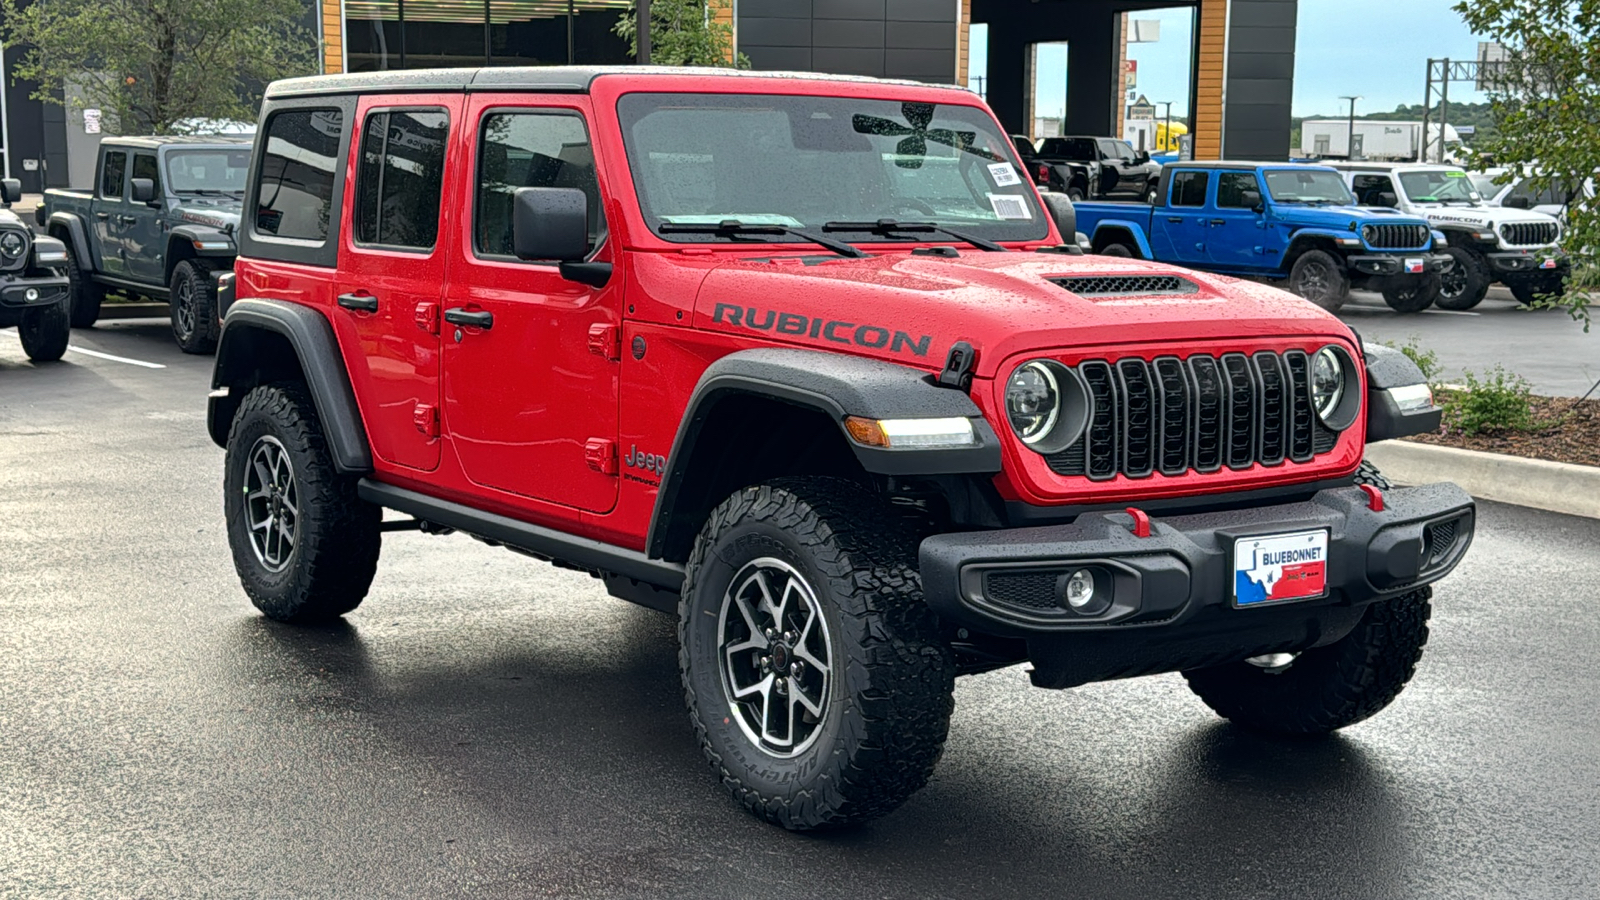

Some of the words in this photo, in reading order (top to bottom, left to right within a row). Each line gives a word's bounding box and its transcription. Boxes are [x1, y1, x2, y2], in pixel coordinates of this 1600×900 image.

[1427, 214, 1483, 224] RUBICON
[713, 303, 932, 356] RUBICON
[624, 444, 666, 477] Jeep
[1263, 547, 1322, 565] BLUEBONNET
